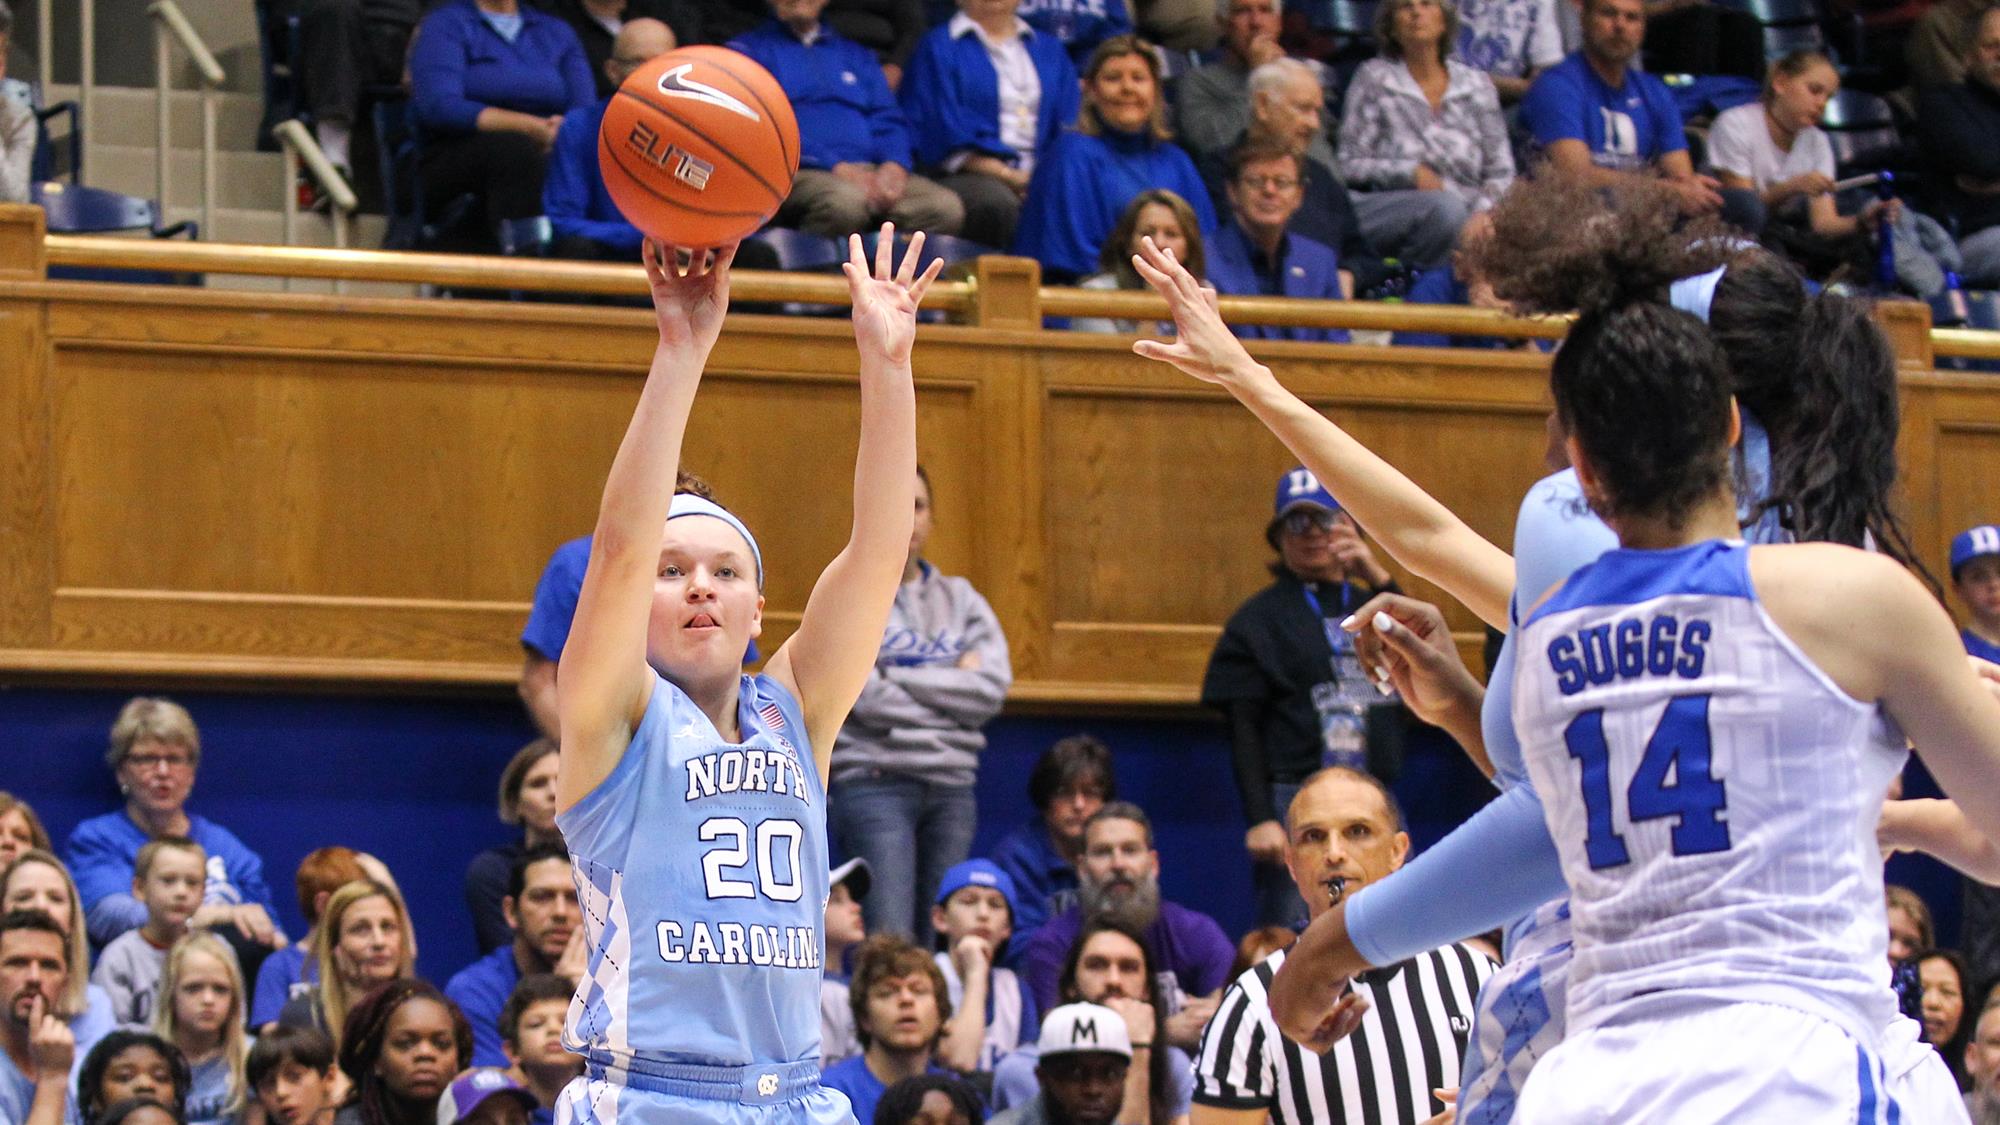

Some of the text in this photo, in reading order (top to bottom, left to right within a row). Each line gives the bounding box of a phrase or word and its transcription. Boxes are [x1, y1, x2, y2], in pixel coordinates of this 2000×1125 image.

[629, 120, 714, 191] ELITE
[1289, 469, 1319, 496] D
[1968, 525, 2000, 553] D
[1547, 615, 1711, 695] SUGGS
[685, 749, 810, 807] NORTH
[1564, 692, 1731, 871] 14
[698, 816, 804, 903] 20
[1072, 1017, 1098, 1044] M
[1450, 1015, 1469, 1031] RJ
